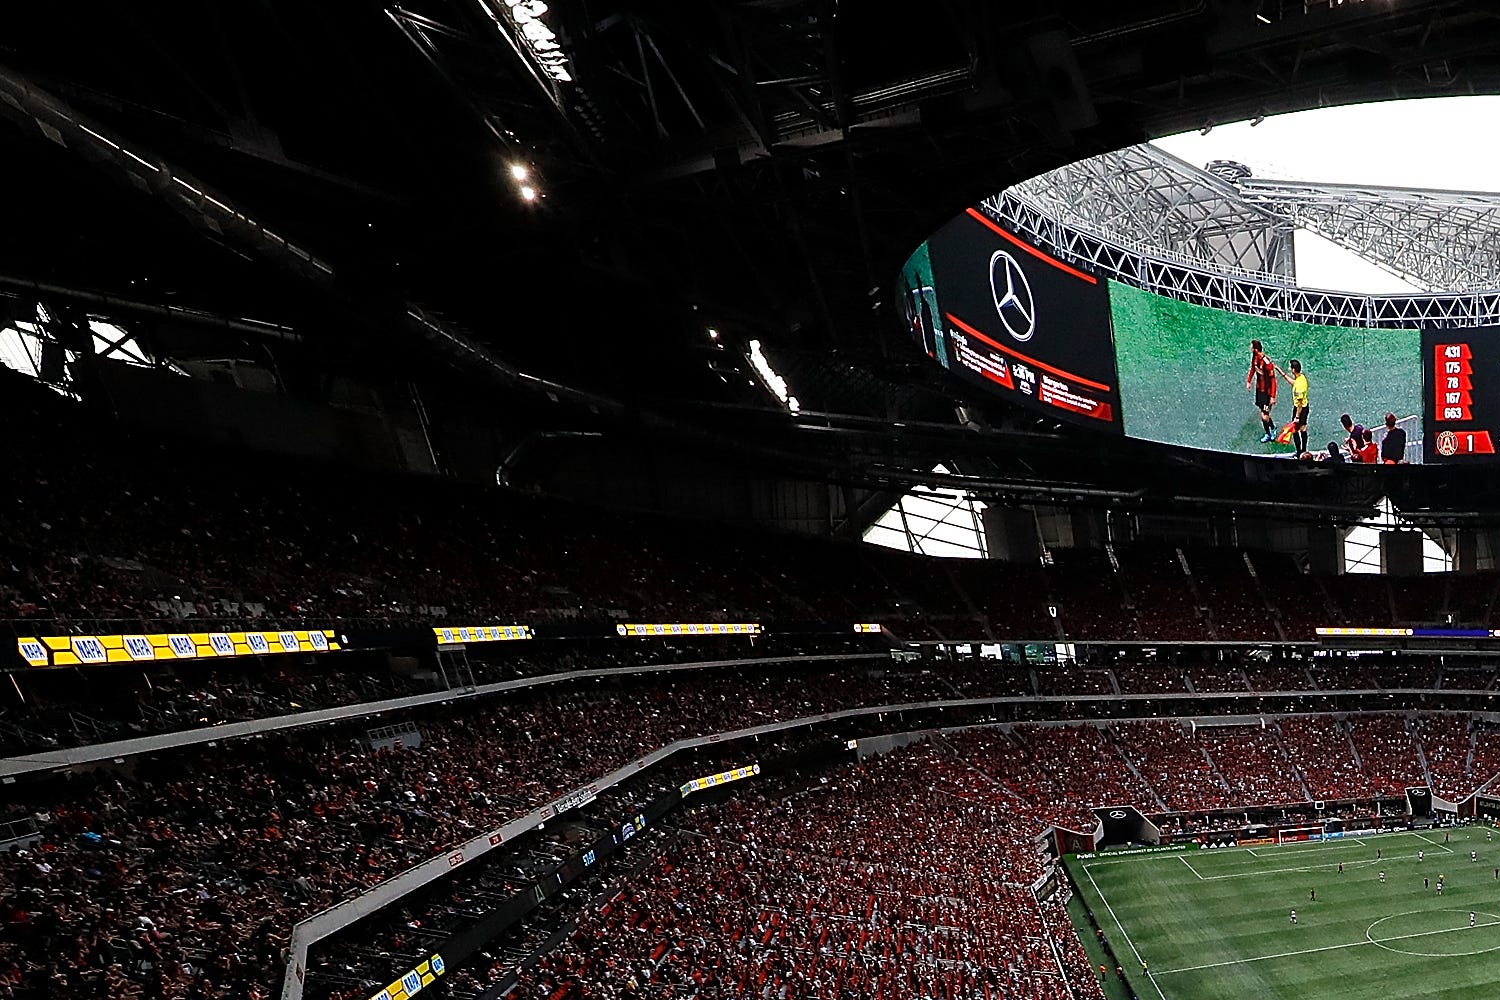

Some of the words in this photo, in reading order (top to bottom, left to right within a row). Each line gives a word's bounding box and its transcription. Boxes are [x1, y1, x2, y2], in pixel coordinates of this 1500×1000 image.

[1444, 346, 1461, 358] 431
[1445, 361, 1461, 374] 175
[1446, 377, 1459, 389] 78
[1445, 392, 1461, 404] 167
[1444, 407, 1462, 419] 663
[1466, 434, 1473, 452] 1
[21, 643, 43, 659] NAPA
[76, 639, 102, 658] NAPA
[128, 638, 150, 656] NAPA
[170, 637, 193, 653] NAPA
[213, 636, 231, 652] NAPA
[404, 973, 421, 993] NAPA
